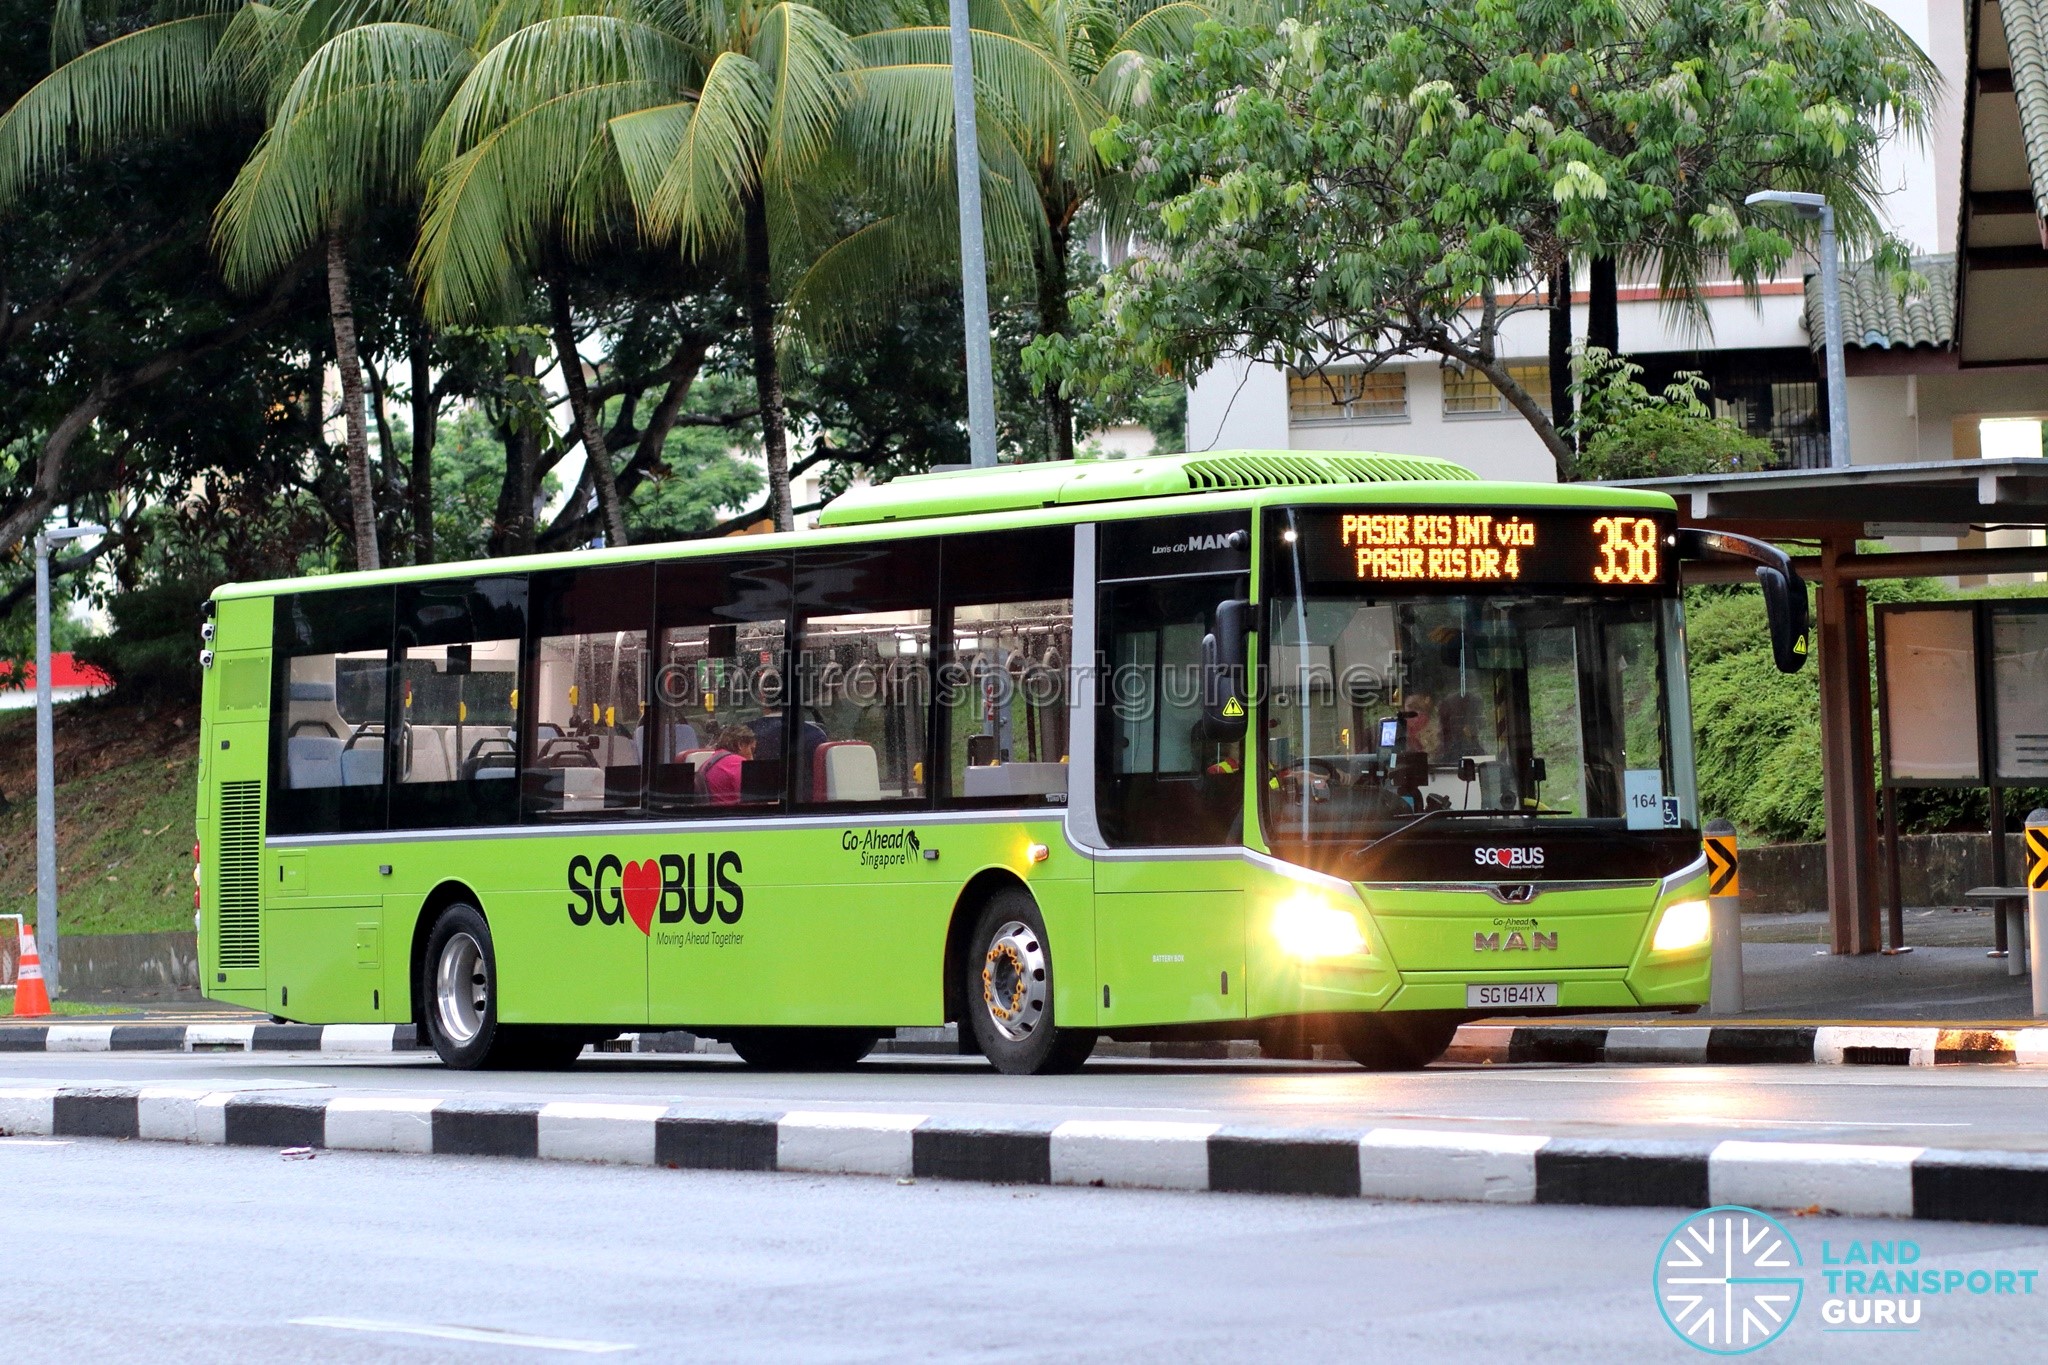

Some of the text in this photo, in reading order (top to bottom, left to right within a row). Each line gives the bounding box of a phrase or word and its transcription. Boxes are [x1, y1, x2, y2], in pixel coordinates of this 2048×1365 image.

[1342, 515, 1535, 546] PASIR RIS INT via
[1173, 543, 1188, 553] City
[1188, 533, 1231, 551] MAN
[1593, 516, 1657, 583] 358
[1357, 548, 1519, 579] PASIR RIS DR 4
[1632, 794, 1657, 808] 164
[842, 828, 904, 850] Go-Ahead
[861, 851, 905, 869] Singapore
[1493, 918, 1529, 926] Go-Ahead
[656, 931, 744, 948] Moving Ahead Together
[1474, 931, 1558, 952] MAN
[1480, 986, 1546, 1004] SG1841X
